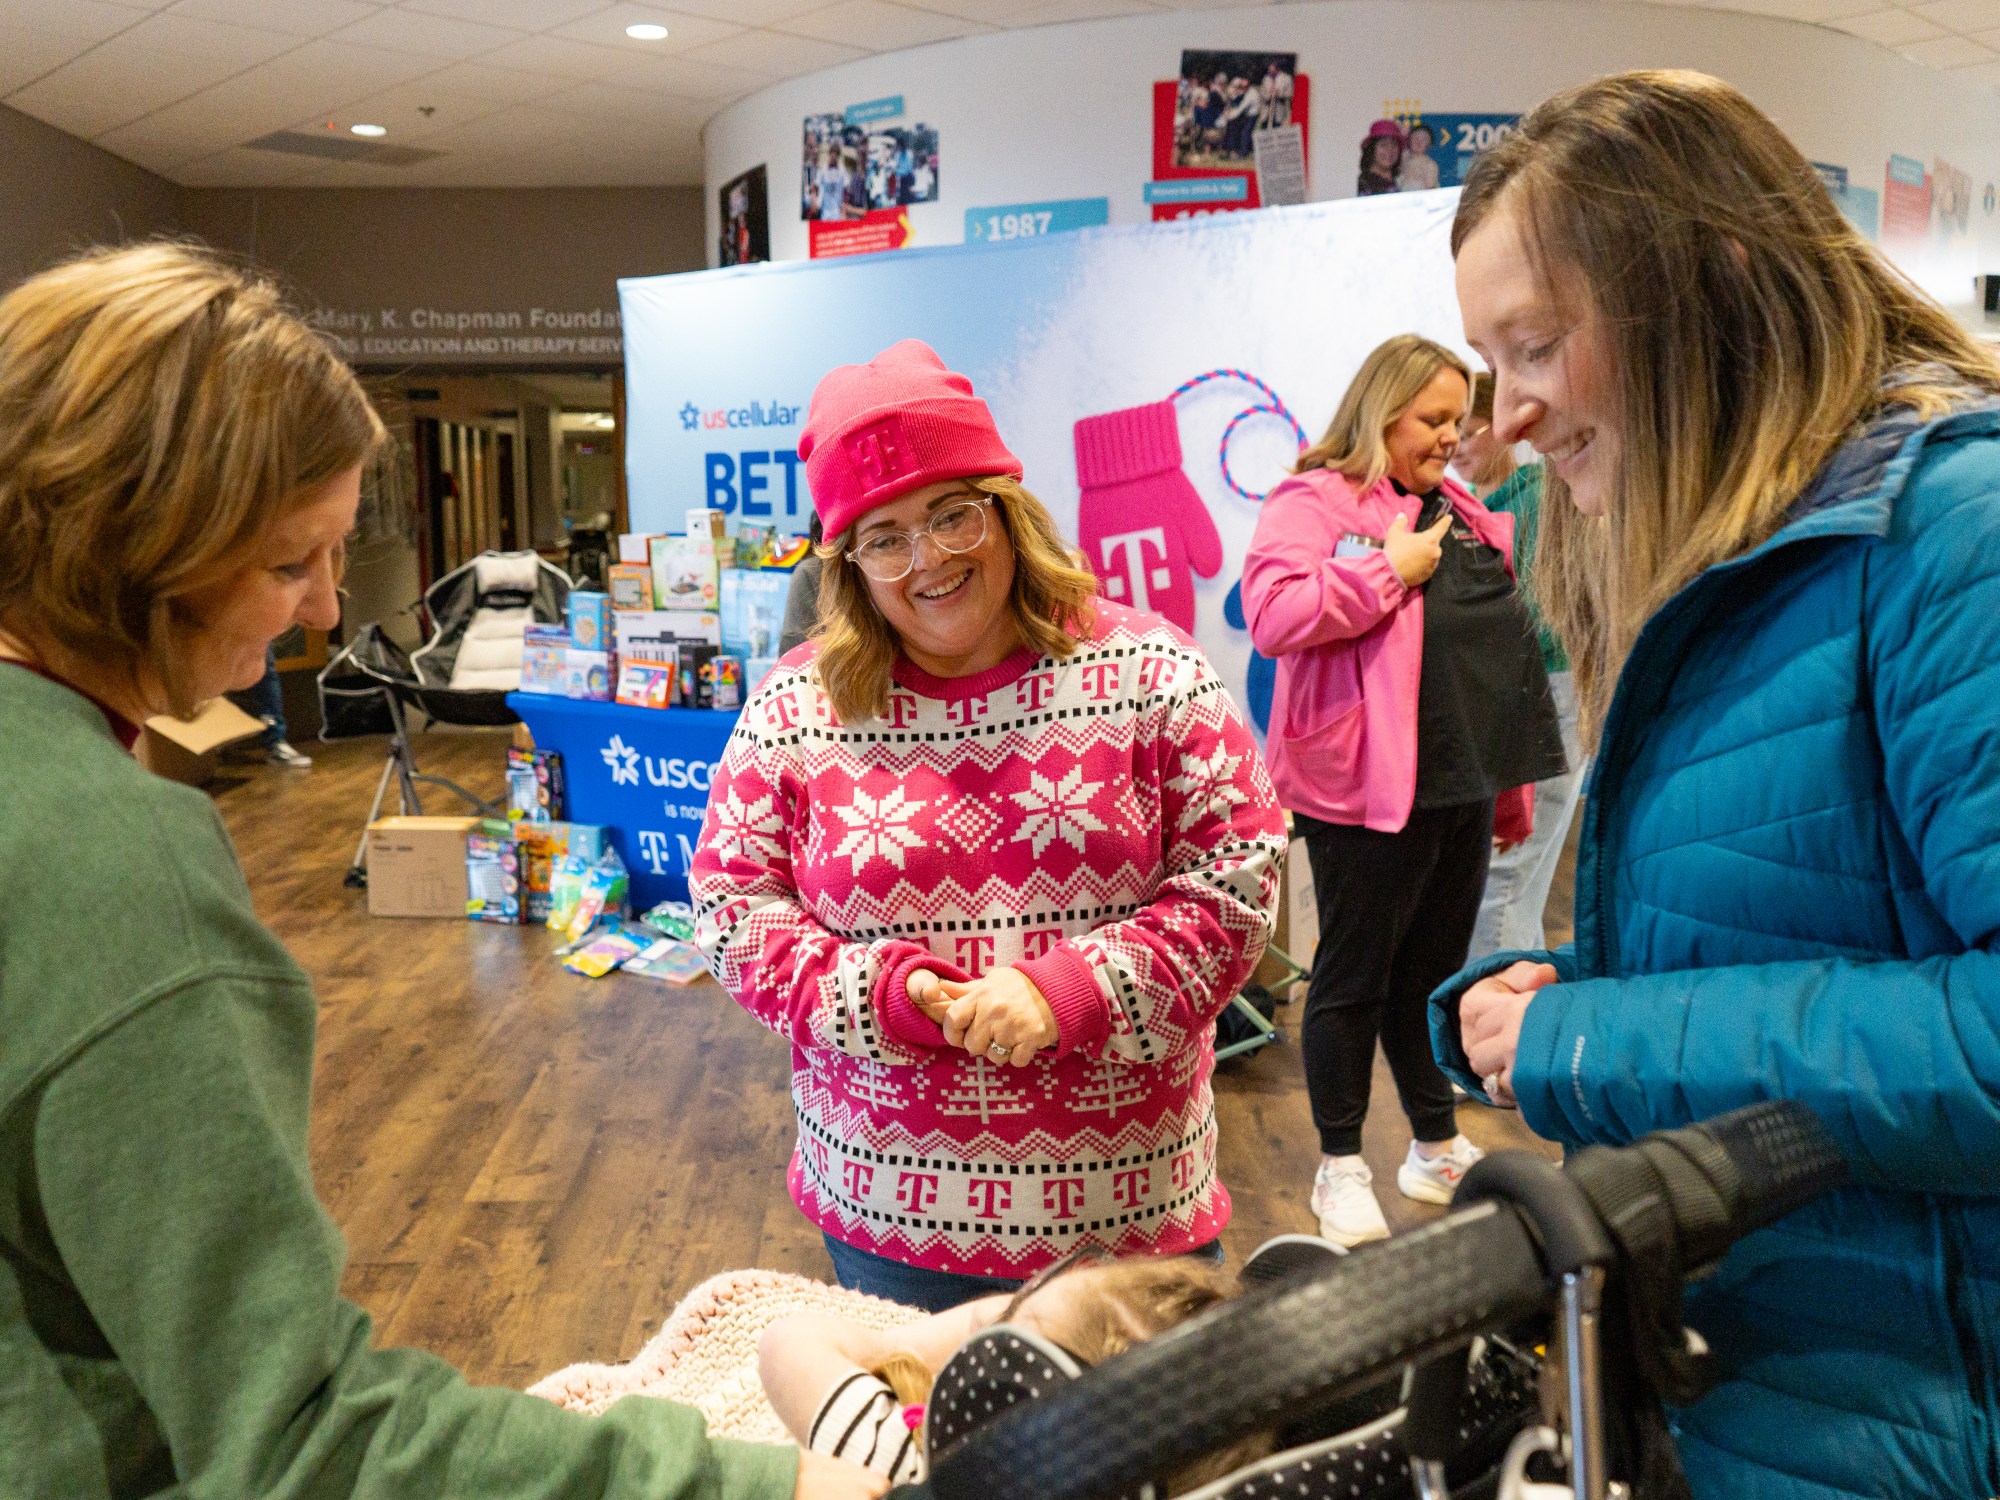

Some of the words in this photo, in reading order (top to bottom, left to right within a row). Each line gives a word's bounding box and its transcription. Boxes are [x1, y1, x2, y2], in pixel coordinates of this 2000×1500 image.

[1457, 122, 1513, 153] 200
[987, 212, 1054, 242] 1987
[410, 308, 522, 332] Chapman
[363, 337, 463, 353] EDUCATION
[463, 337, 500, 353] AND
[577, 337, 622, 354] SERV
[703, 400, 801, 429] uscellular
[705, 450, 807, 516] BET
[1100, 526, 1172, 617] T
[764, 692, 799, 731] T
[880, 695, 917, 729] T
[946, 693, 988, 727] T
[1017, 672, 1054, 712] T
[1082, 663, 1119, 700] T
[1138, 656, 1178, 695] T
[663, 799, 678, 818] is
[638, 830, 670, 875] T
[955, 936, 995, 979] T
[843, 1160, 874, 1203] T
[896, 1171, 939, 1214] T
[967, 1178, 1012, 1219] T
[1043, 1178, 1085, 1220] T
[1113, 1167, 1150, 1209] T
[1171, 1150, 1195, 1192] T
